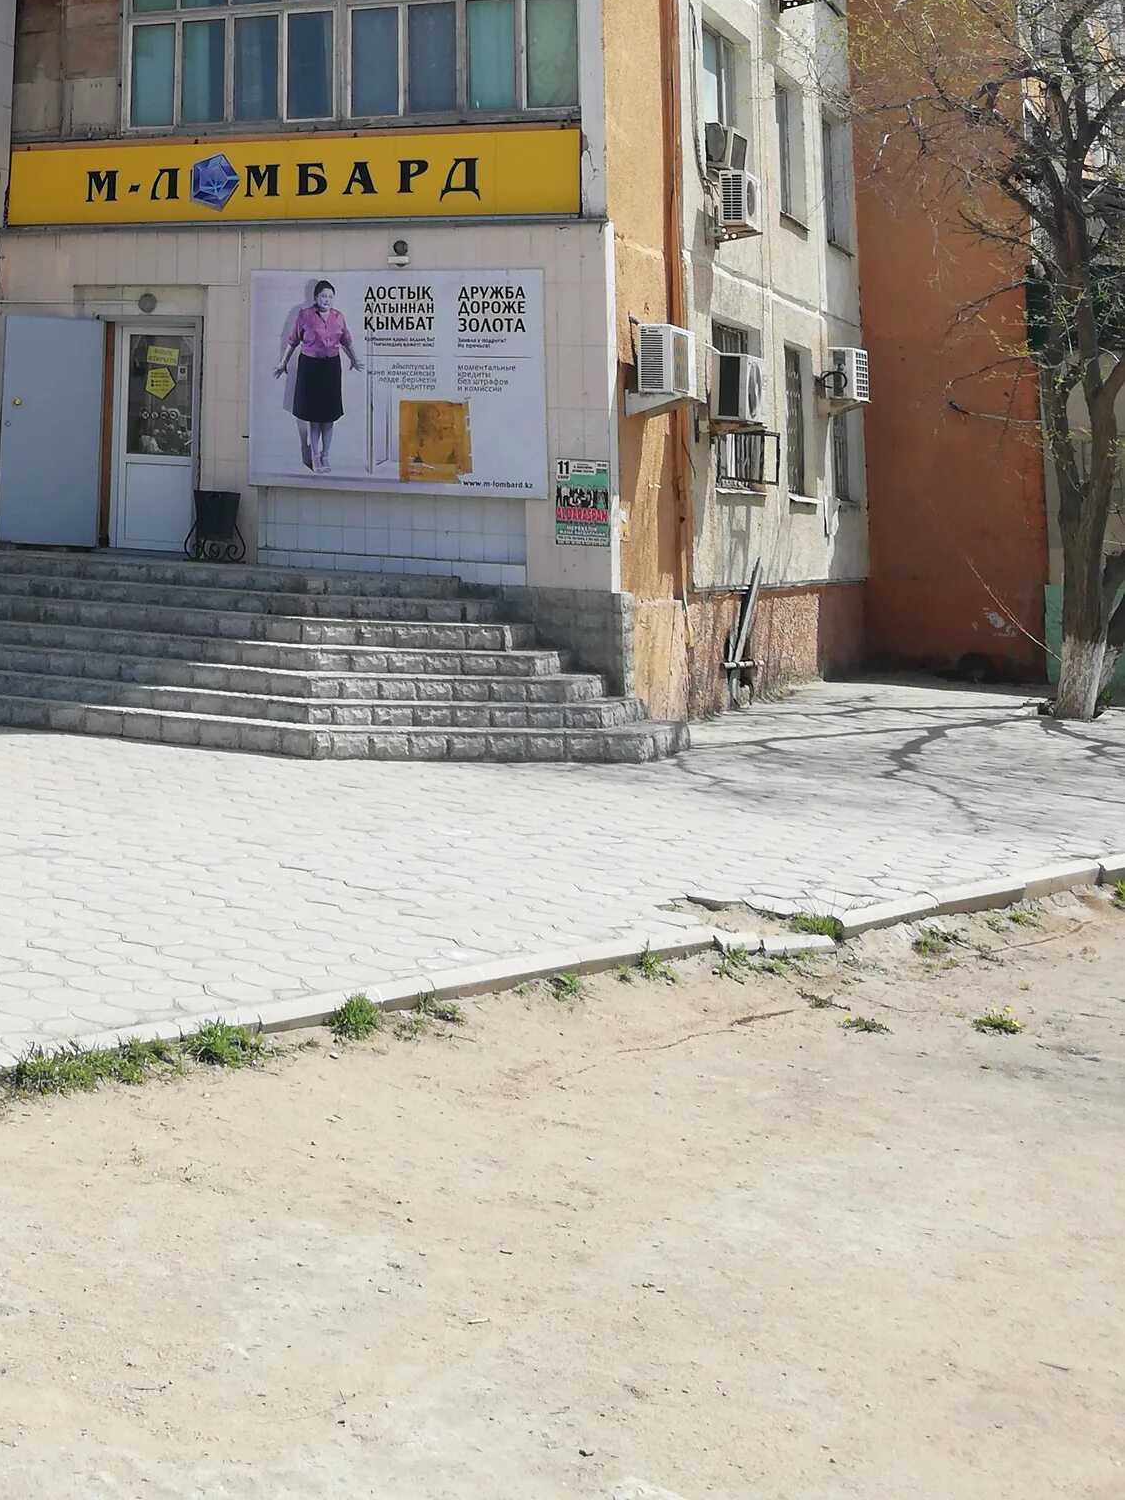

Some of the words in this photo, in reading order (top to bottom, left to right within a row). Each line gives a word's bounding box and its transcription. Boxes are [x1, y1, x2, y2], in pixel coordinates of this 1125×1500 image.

[86, 156, 481, 203] М-ЛМБАРД
[364, 286, 433, 302] ДОСТЫҚ
[458, 286, 526, 301] ДРУЖБА
[364, 303, 434, 314] АЛТЫННАН
[458, 301, 526, 316] ДОРОЖЕ
[364, 316, 434, 332] ҚЫМБАТ
[458, 318, 526, 333] ЗОЛОТА
[473, 378, 508, 386] штрафов
[557, 461, 570, 475] 11
